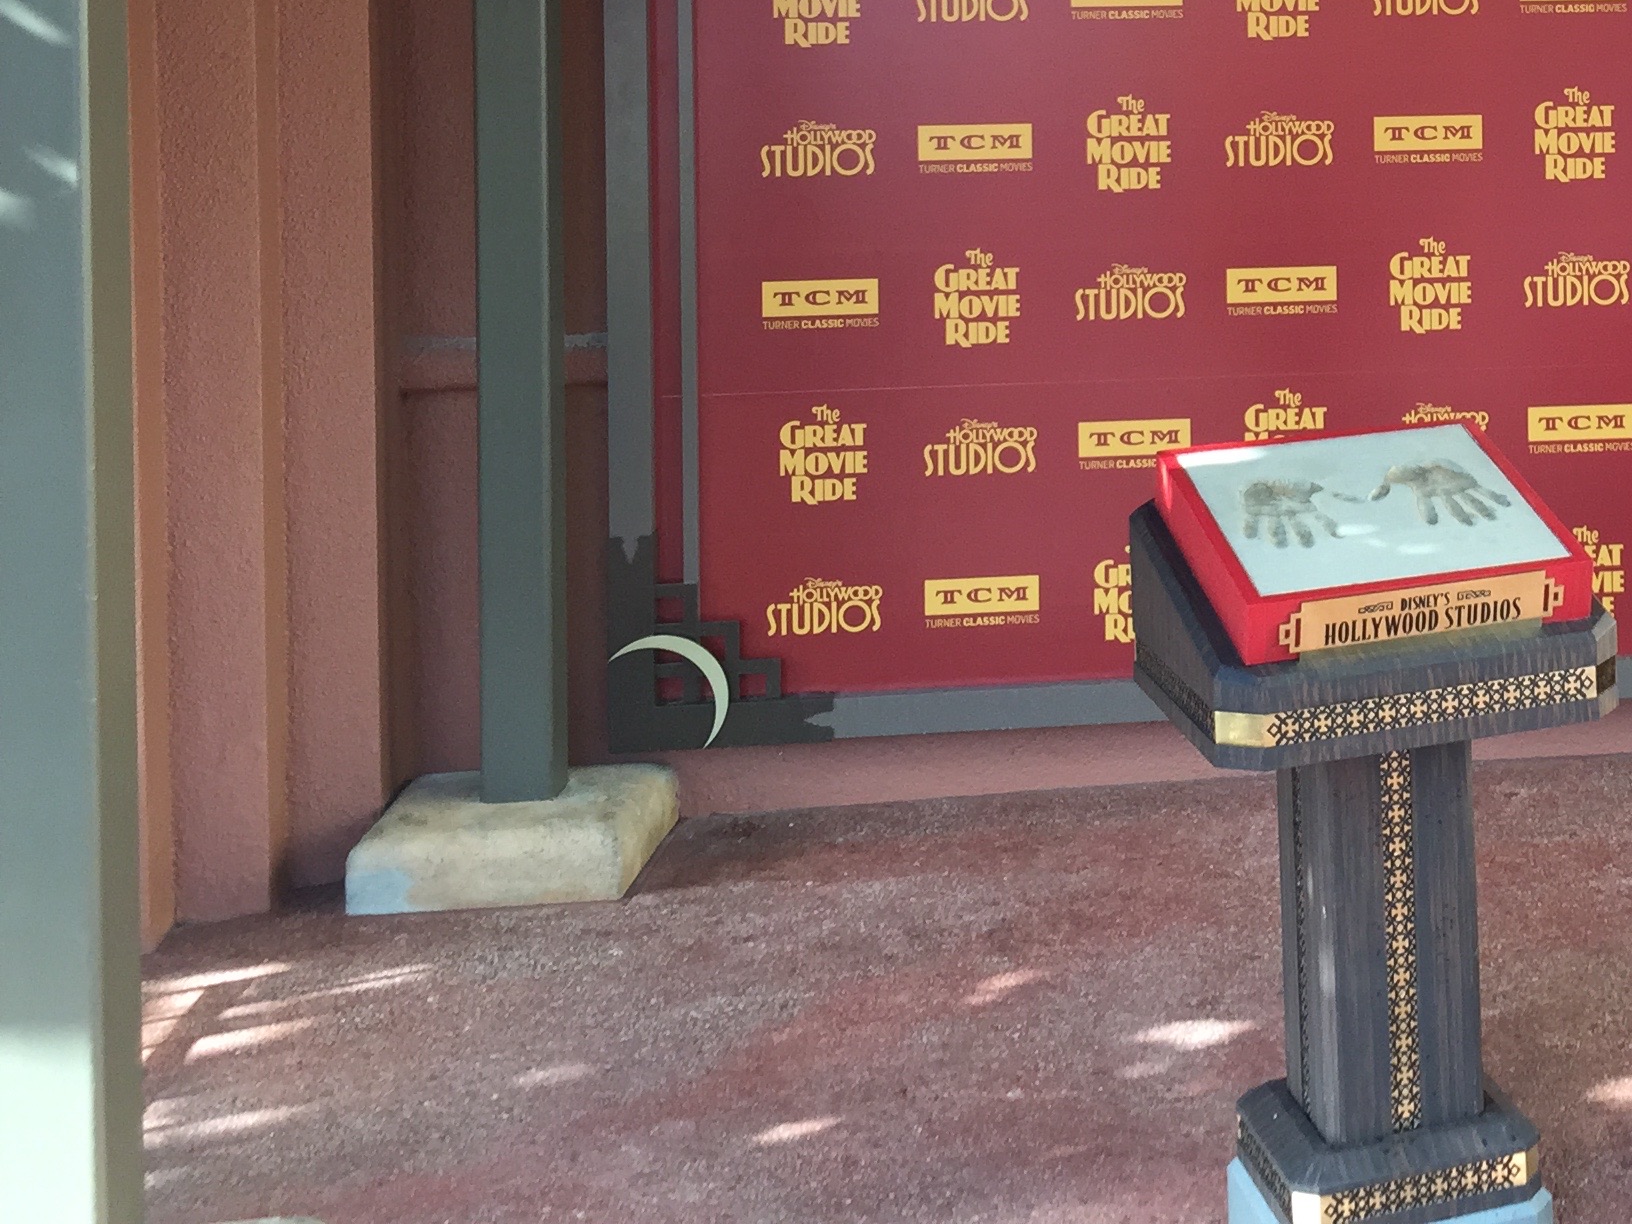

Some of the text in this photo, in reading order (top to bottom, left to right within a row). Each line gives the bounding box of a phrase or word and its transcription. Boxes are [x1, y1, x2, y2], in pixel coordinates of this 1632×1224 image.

[785, 18, 850, 47] RIDE
[1247, 12, 1311, 41] RIDE
[1564, 85, 1590, 104] The
[1086, 110, 1170, 139] GREAT
[1246, 119, 1334, 137] HOLLYWOOD
[1534, 102, 1614, 130] GREAT
[929, 134, 1021, 150] TCM
[1384, 125, 1472, 141] TCM
[1534, 128, 1615, 155] MOVIE
[761, 144, 874, 177] STUDIOS
[1086, 138, 1171, 166] MOVIE
[1225, 135, 1333, 167] STUDIOS
[1097, 164, 1162, 193] RIDE
[1545, 154, 1607, 182] RIDE
[1419, 235, 1446, 254] The
[934, 264, 1019, 293] GREAT
[1389, 252, 1471, 281] GREAT
[1544, 259, 1630, 278] HOLLYWOOD
[774, 290, 867, 305] TCM
[1237, 277, 1326, 293] TCM
[1389, 279, 1472, 307] MOVIE
[1524, 275, 1629, 307] STUDIOS
[934, 292, 1020, 320] MOVIE
[1075, 287, 1185, 320] STUDIOS
[763, 318, 879, 330] TURNER CLASSIC MOVIES
[946, 318, 1011, 348] RIDE
[1400, 305, 1464, 334] RIDE
[812, 402, 841, 422] The
[1244, 404, 1325, 431] GREAT
[1538, 414, 1625, 430] TCM
[780, 420, 867, 449] GREAT
[945, 426, 1037, 445] HOLLYWOOD
[1089, 430, 1180, 445] TCM
[780, 448, 868, 477] MOVIE
[924, 442, 1036, 476] STUDIOS
[792, 475, 859, 505] RIDE
[1573, 525, 1599, 545] The
[1584, 544, 1624, 567] EAT
[789, 586, 883, 605] HOLLYWOOD
[936, 587, 1028, 603] TCM
[1592, 570, 1625, 593] VIE
[1400, 592, 1451, 611] DISNEY'S
[767, 602, 882, 636] STUDIOS
[1324, 597, 1522, 646] HOLLYWOOD STUDIOS
